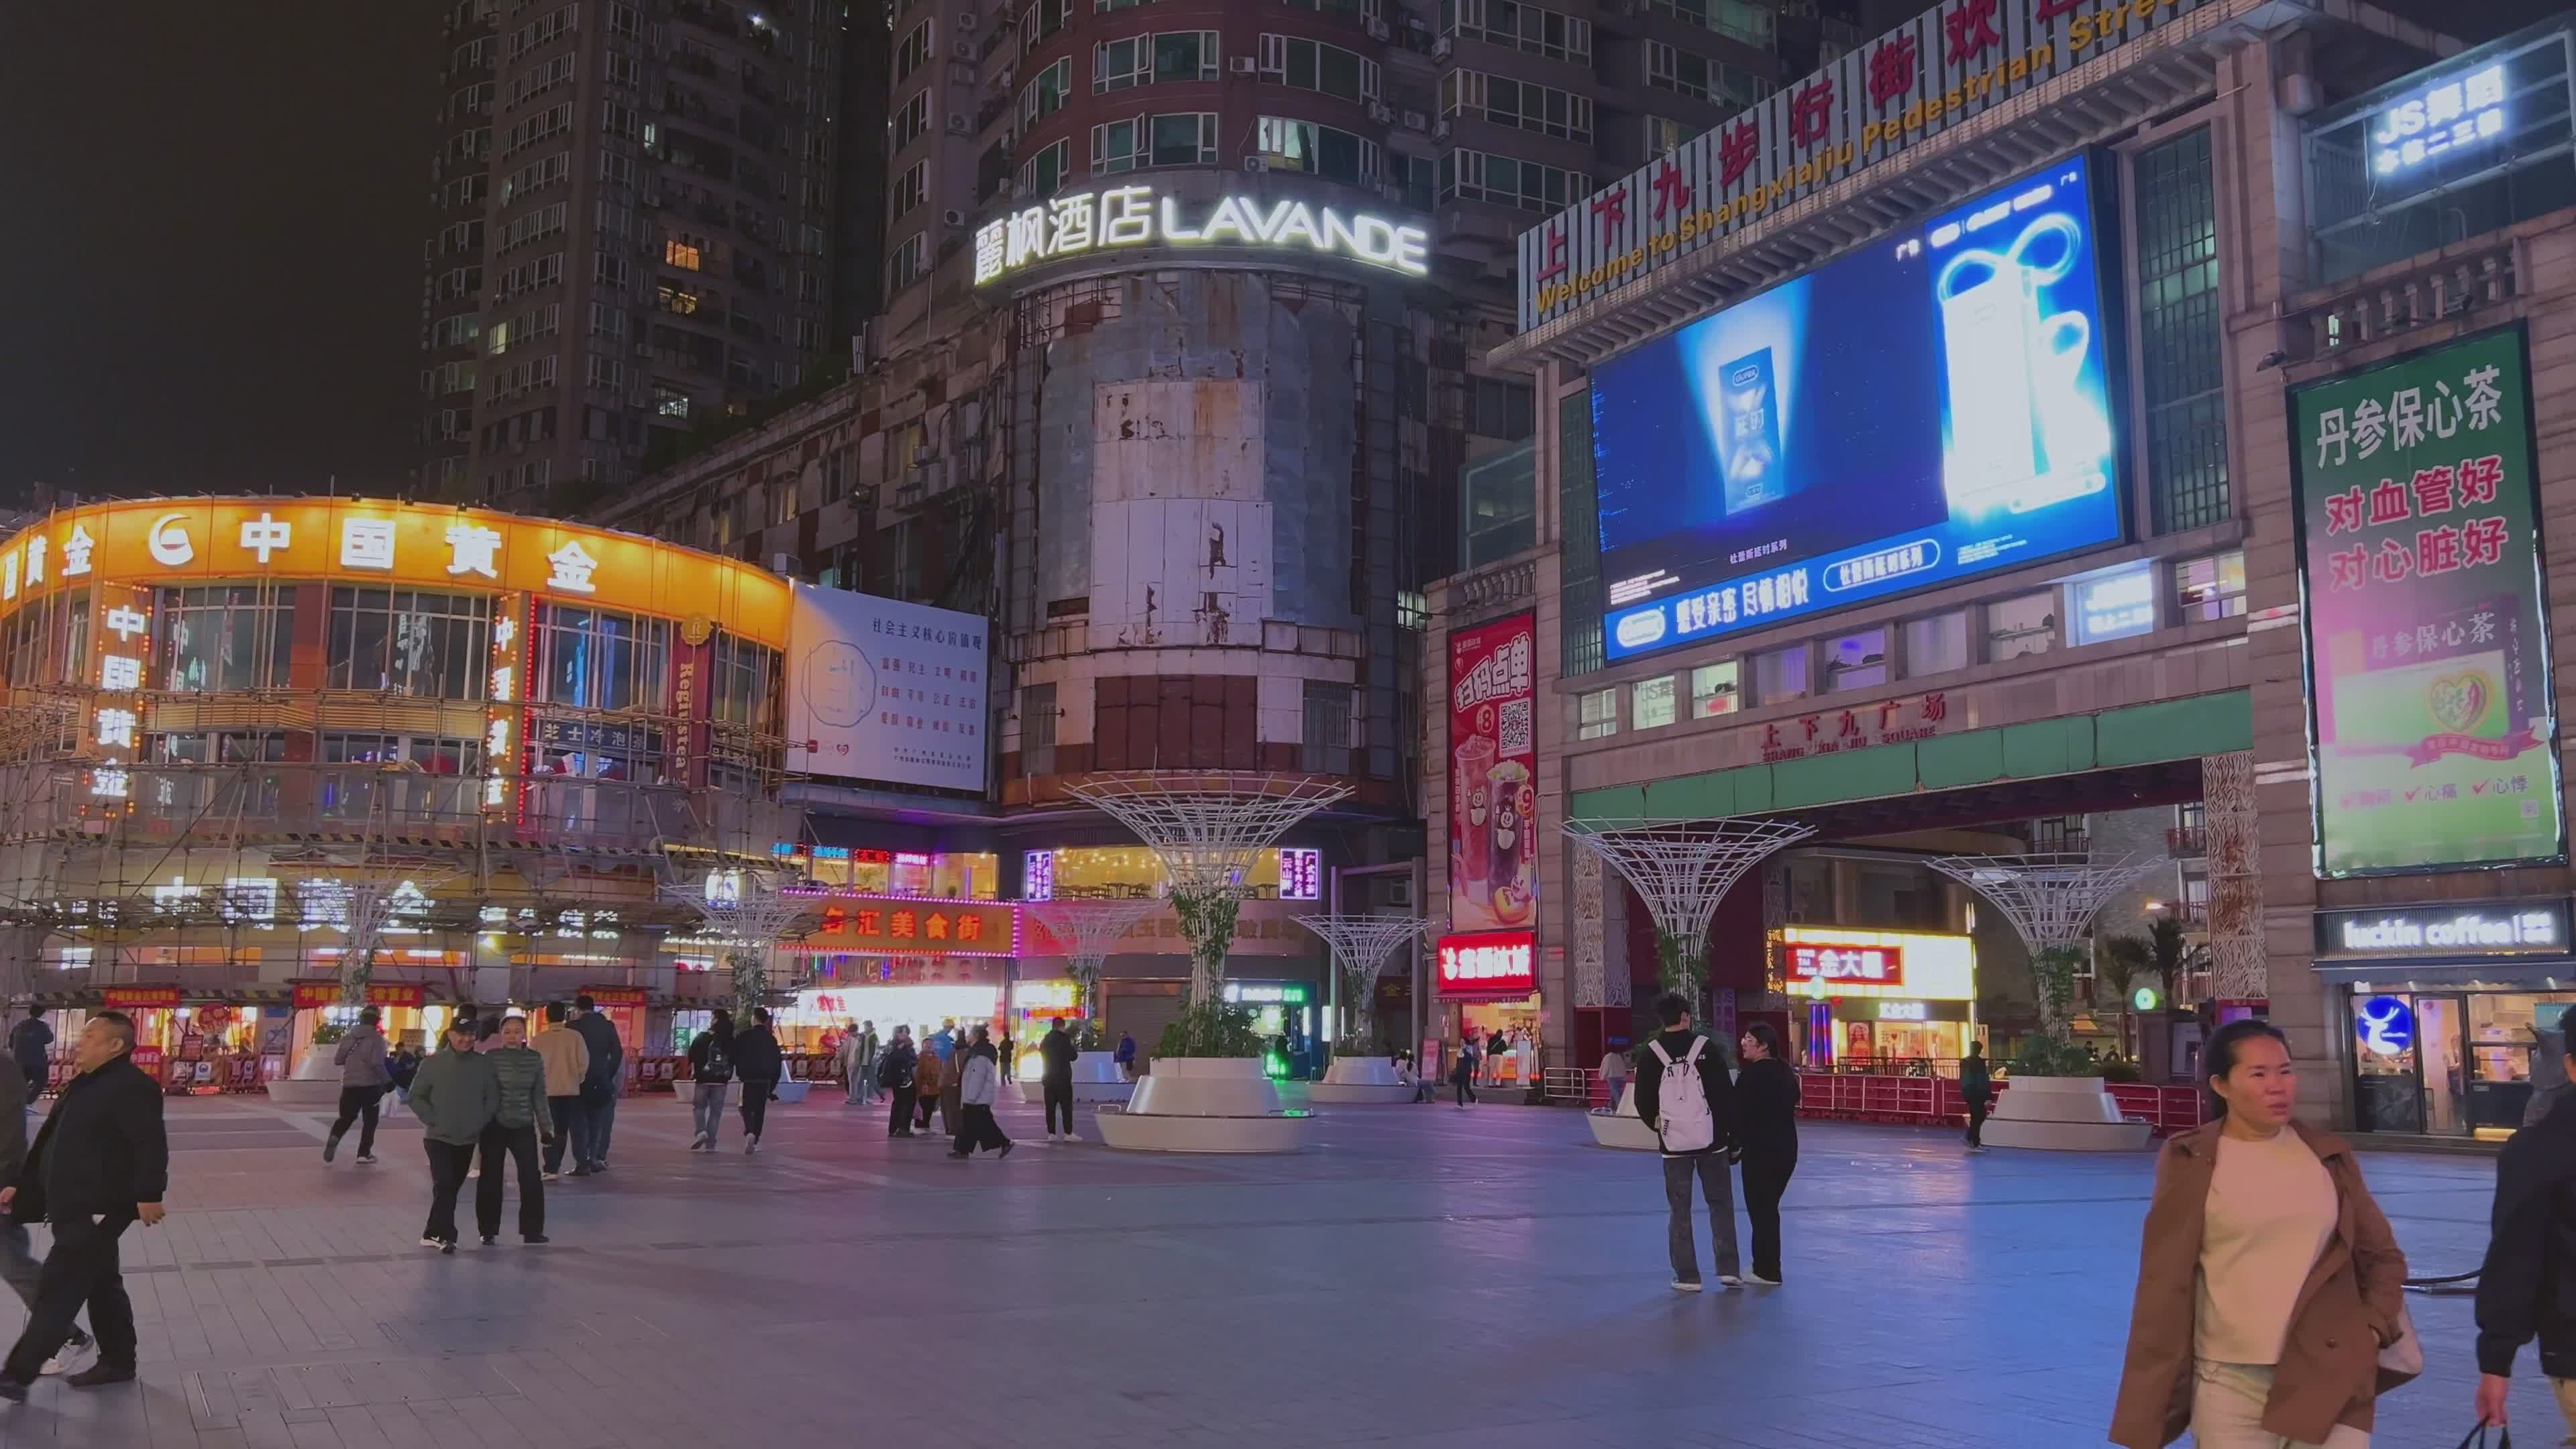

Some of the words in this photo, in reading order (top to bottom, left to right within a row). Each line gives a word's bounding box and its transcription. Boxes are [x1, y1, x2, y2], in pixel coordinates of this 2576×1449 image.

[1535, 246, 1643, 313] Welcome
[1648, 229, 1676, 259] to
[1679, 140, 1854, 241] Shangxiajiu
[1862, 41, 2055, 155] Pedestrian
[1537, 0, 2089, 280] 上下九步行街欢
[1161, 195, 1428, 275] LAVANDE
[2316, 365, 2503, 469] 丹参保心茶
[2326, 455, 2503, 537] 对血管好
[240, 512, 598, 593] 中国黄金
[2329, 517, 2509, 592] 对心脏好
[873, 617, 982, 650] 社会主义核心价值观
[1456, 633, 1530, 711] 扫码点单
[91, 604, 146, 797] 中国黄金
[485, 615, 515, 806] 中国黄金
[1761, 693, 1946, 749] 上下九广场
[1763, 745, 1805, 763] SHANG
[1882, 725, 1937, 744] SQUARE
[2344, 918, 2422, 949] luckin
[2426, 914, 2512, 947] coffee
